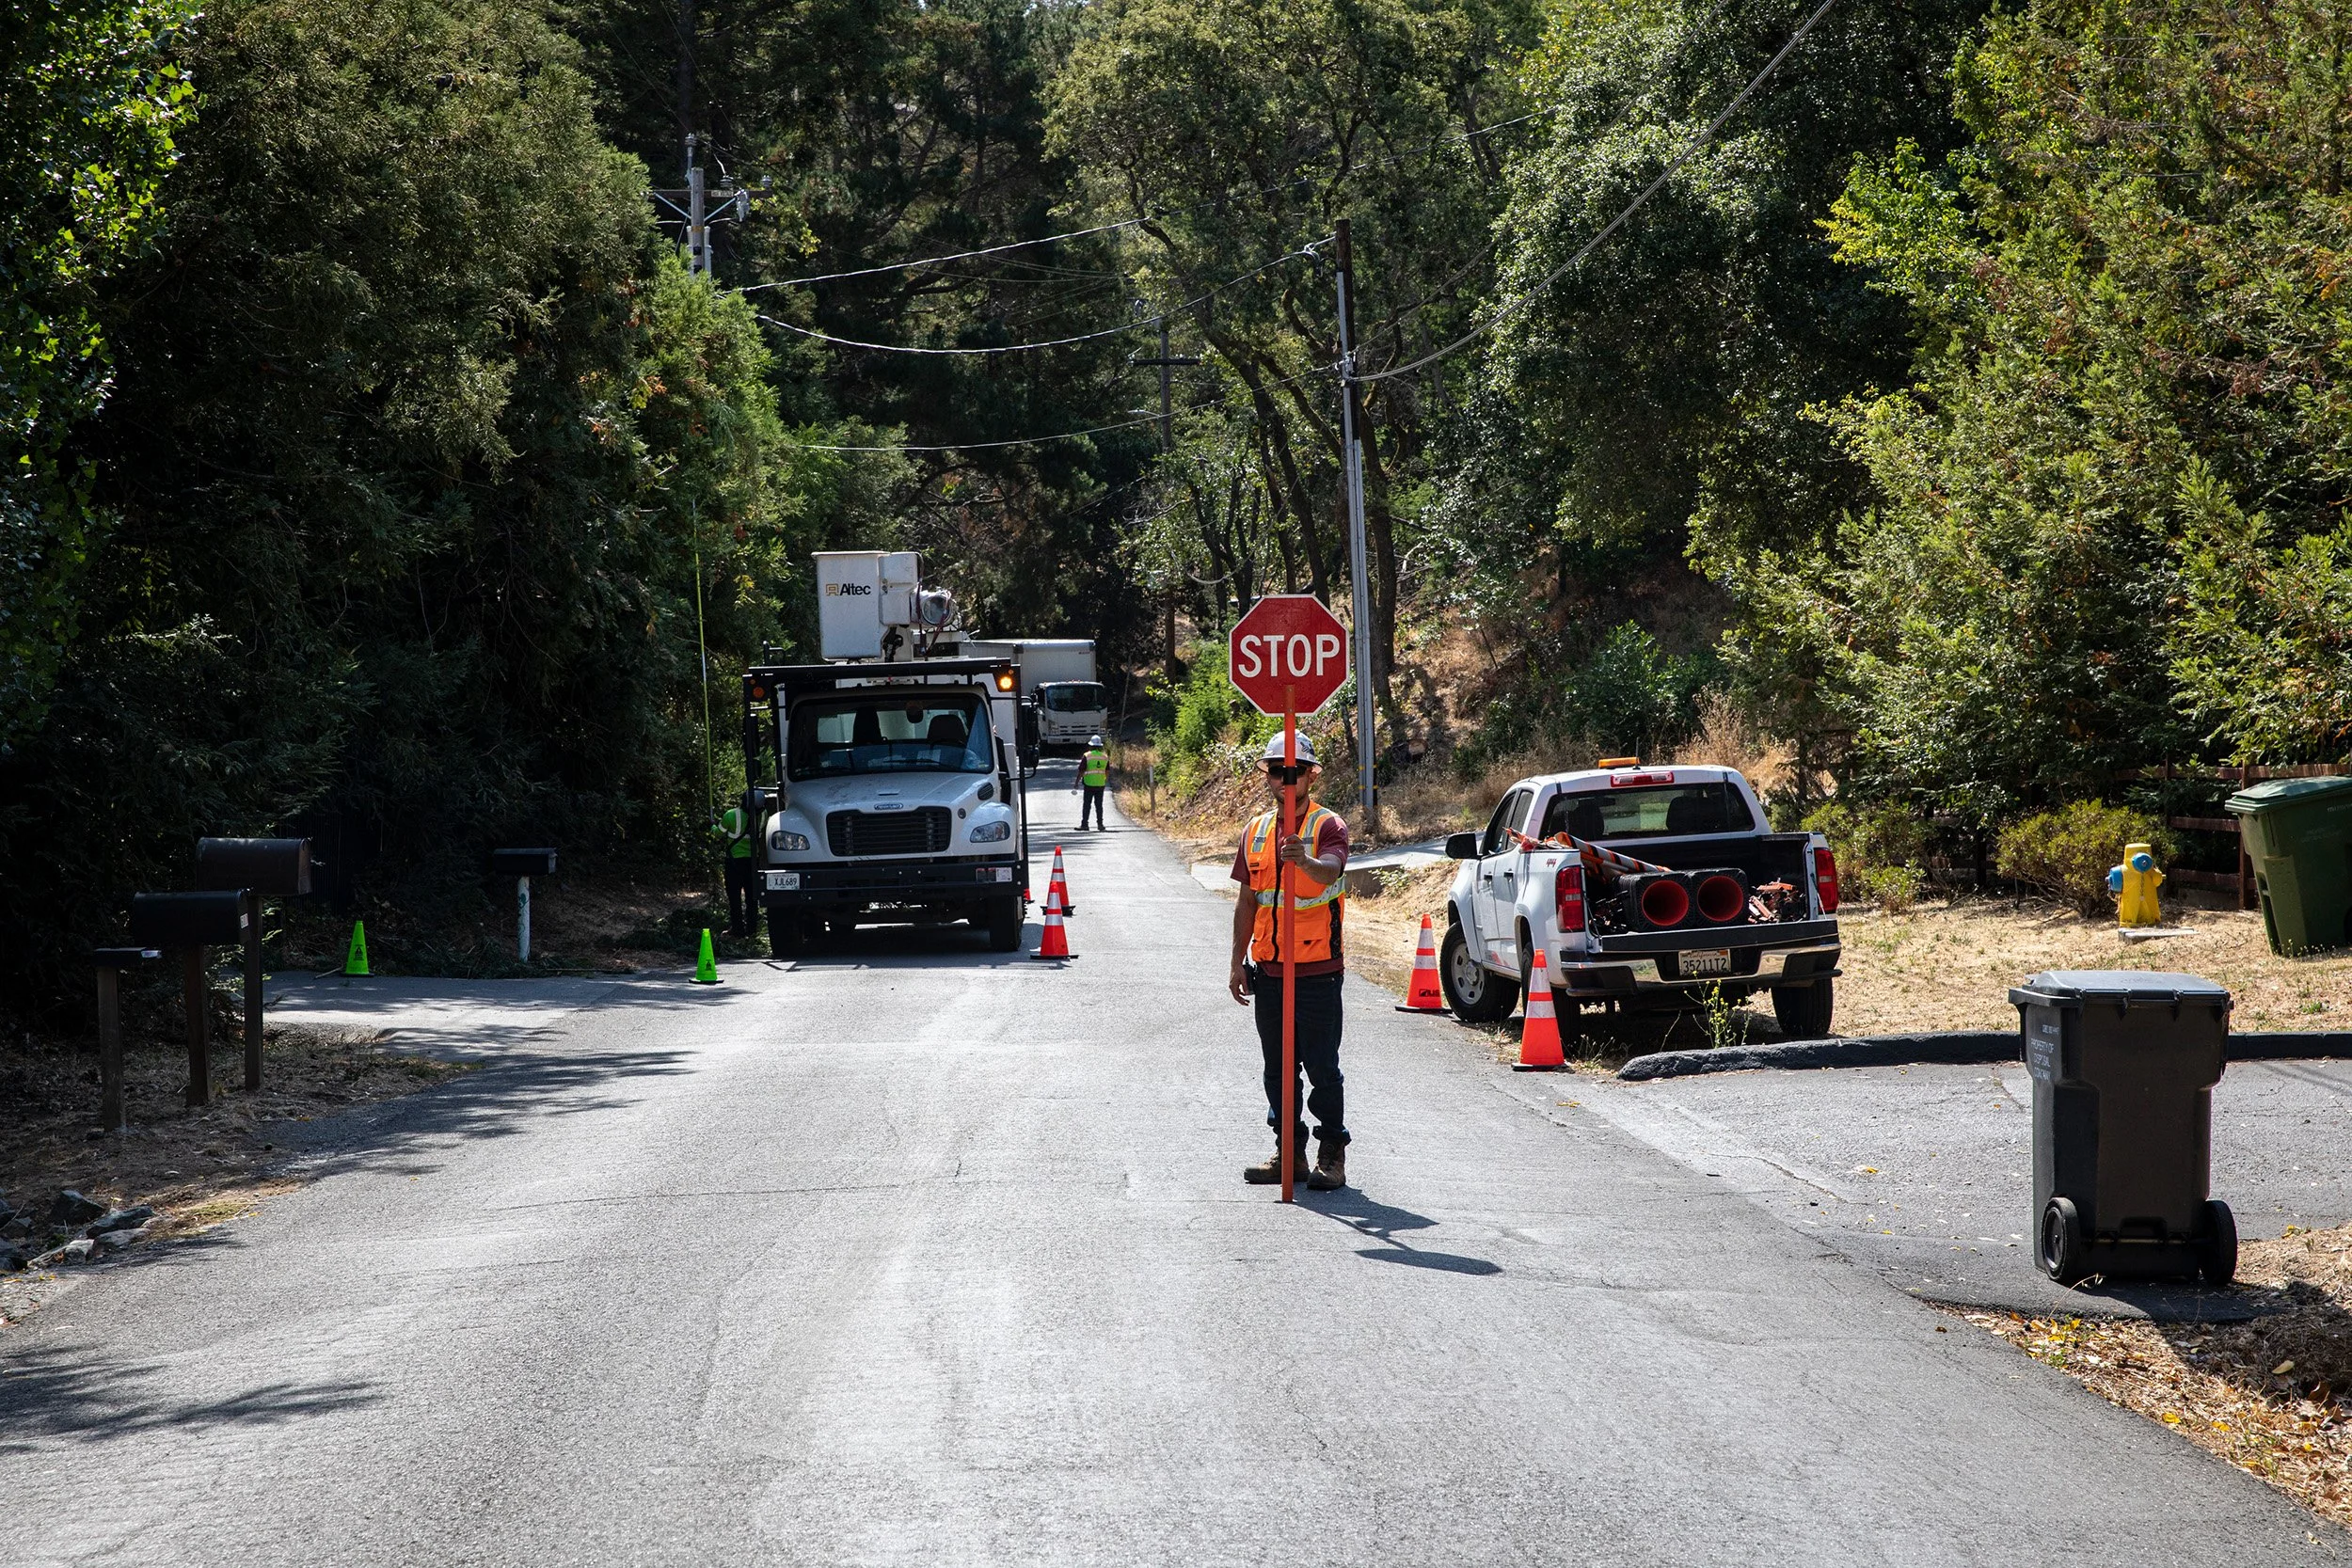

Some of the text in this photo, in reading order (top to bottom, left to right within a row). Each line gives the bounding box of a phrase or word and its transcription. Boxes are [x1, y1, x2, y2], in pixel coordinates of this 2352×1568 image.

[840, 583, 871, 596] Altec
[1238, 634, 1341, 677] STOP
[1683, 958, 1727, 973] 35211T2
